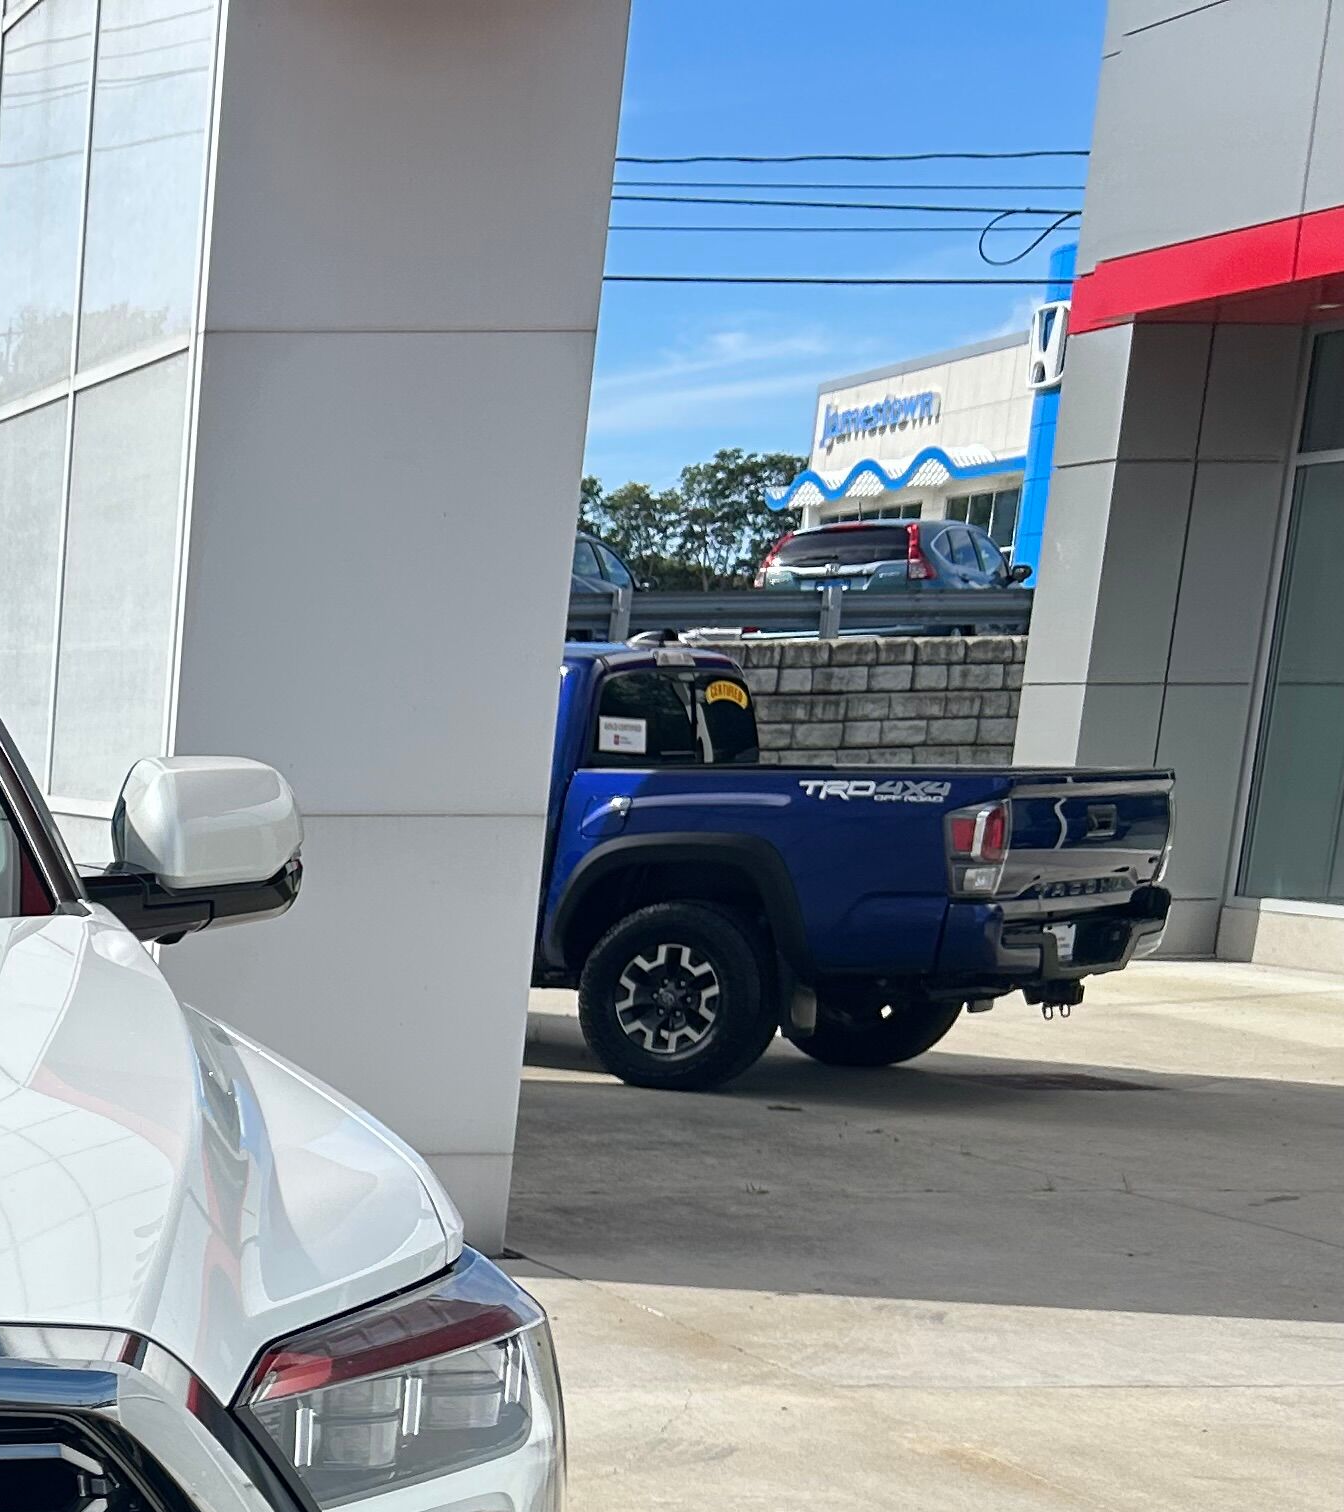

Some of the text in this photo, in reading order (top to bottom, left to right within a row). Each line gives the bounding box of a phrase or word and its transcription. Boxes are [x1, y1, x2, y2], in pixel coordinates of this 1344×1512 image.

[820, 392, 935, 448] Jamestown
[711, 684, 743, 702] CERTIFIED
[799, 780, 951, 800] TRD 4X4
[904, 795, 944, 803] ROAD
